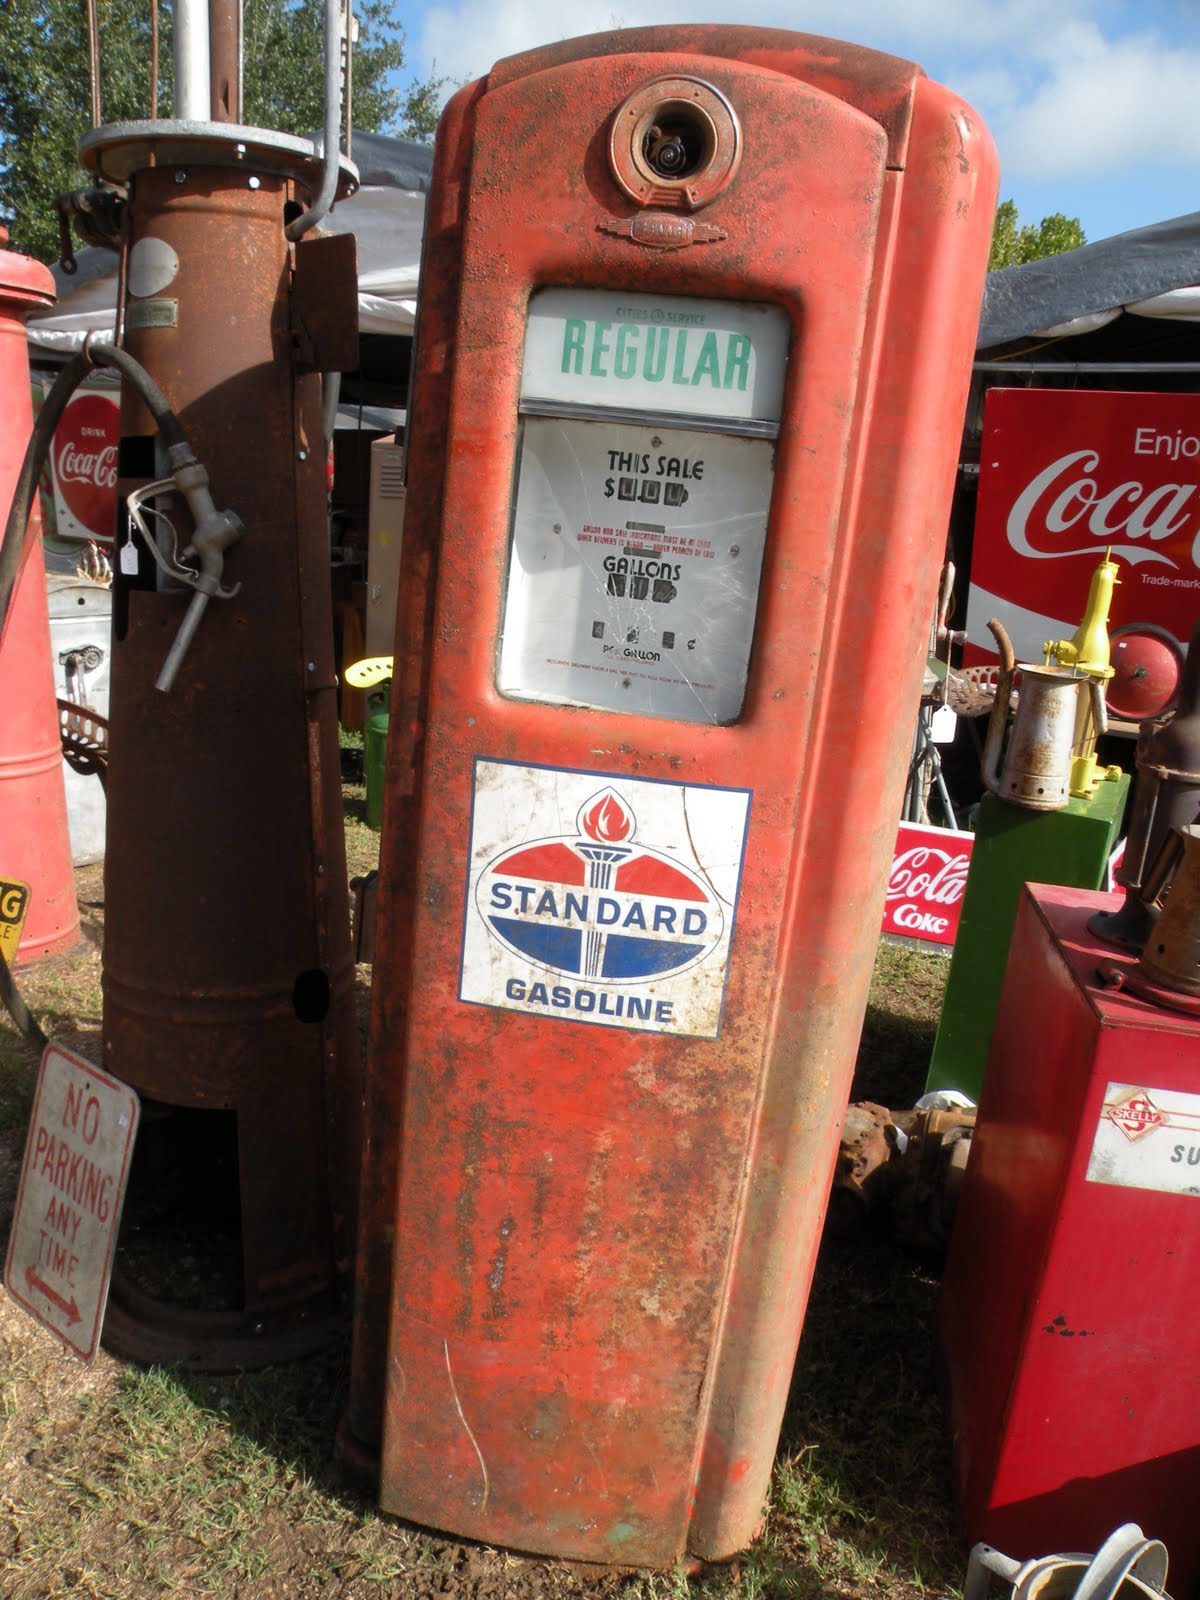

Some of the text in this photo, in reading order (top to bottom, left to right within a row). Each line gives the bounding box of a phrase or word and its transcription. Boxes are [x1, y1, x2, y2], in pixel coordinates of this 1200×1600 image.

[616, 307, 706, 325] CITIES SERVICE
[561, 318, 752, 391] REGULAR
[81, 427, 106, 438] DRINK
[607, 450, 704, 480] THIS SALE
[1006, 449, 1200, 570] Coca
[603, 555, 681, 581] GALLONS
[1141, 573, 1200, 589] Trade-mark
[490, 882, 708, 936] STANDARD
[893, 903, 949, 934] Coke
[505, 978, 674, 1023] GASOLINE
[62, 1081, 100, 1145] NO
[1115, 1109, 1159, 1122] SKELLY
[32, 1125, 114, 1224] PARKING
[45, 1195, 82, 1244] ANY
[37, 1228, 80, 1288] TIME
